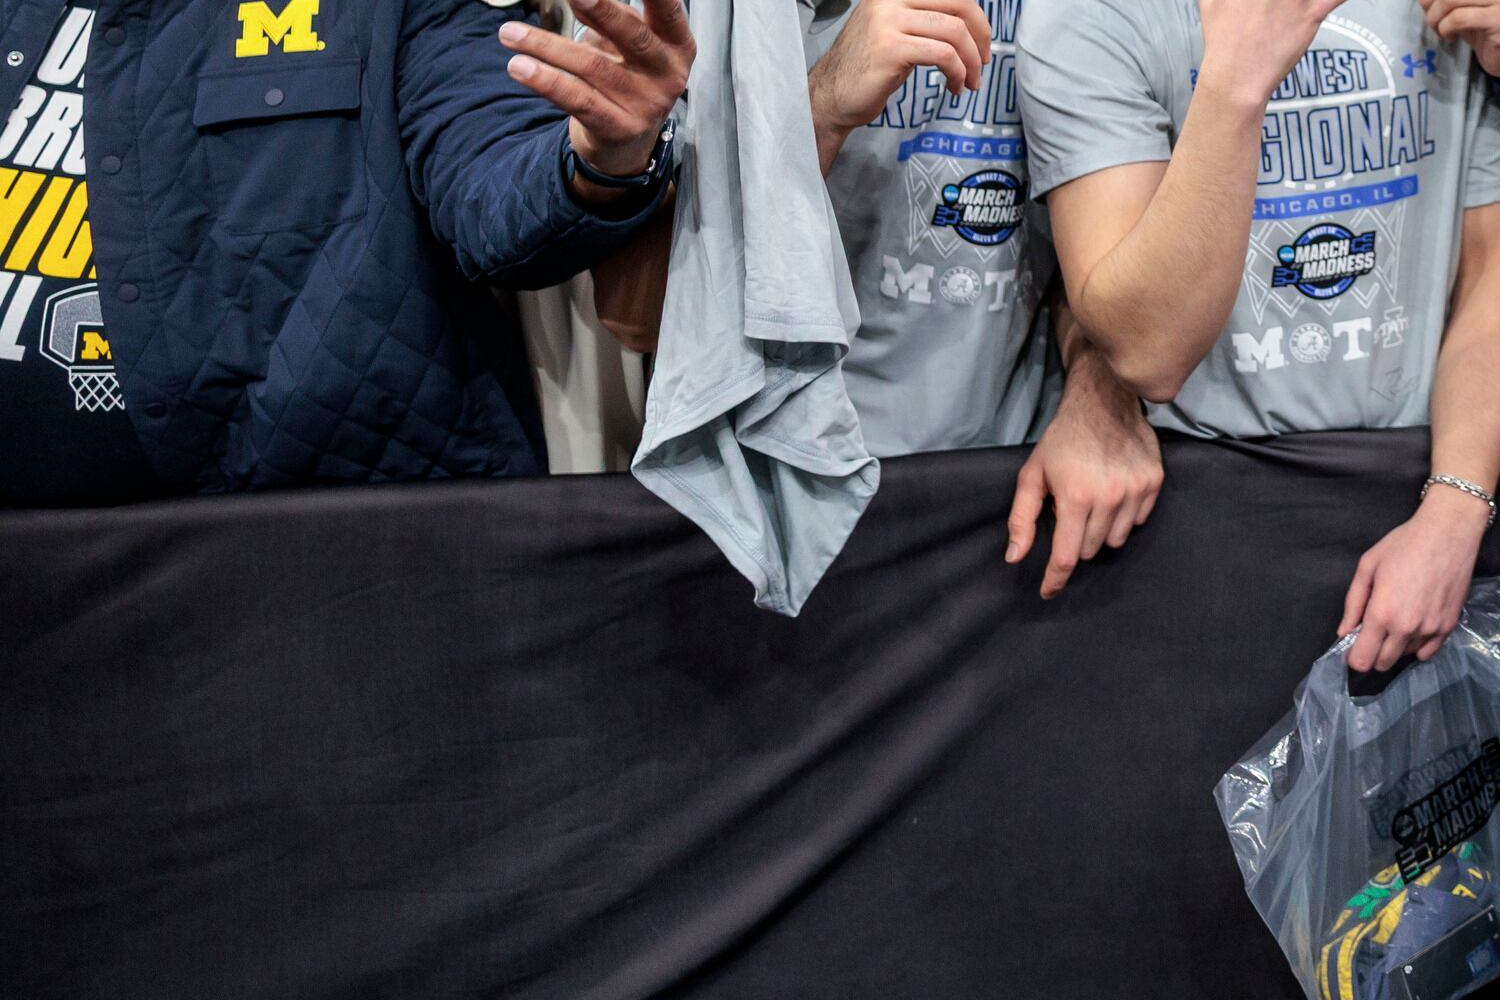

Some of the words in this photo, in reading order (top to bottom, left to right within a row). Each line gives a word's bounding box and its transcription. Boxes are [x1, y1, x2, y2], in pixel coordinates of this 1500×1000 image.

[1270, 48, 1369, 101] DWEST
[920, 136, 1021, 157] CHICAG
[1256, 90, 1436, 186] GIONAL
[958, 186, 1017, 206] MARCH
[1373, 186, 1394, 201] IL
[1295, 239, 1350, 263] MARCH
[1302, 251, 1376, 280] MADNESS
[880, 254, 935, 305] M
[984, 269, 1017, 312] T
[1232, 326, 1285, 373] M
[1332, 316, 1372, 361] T
[1412, 764, 1482, 830] MARCH
